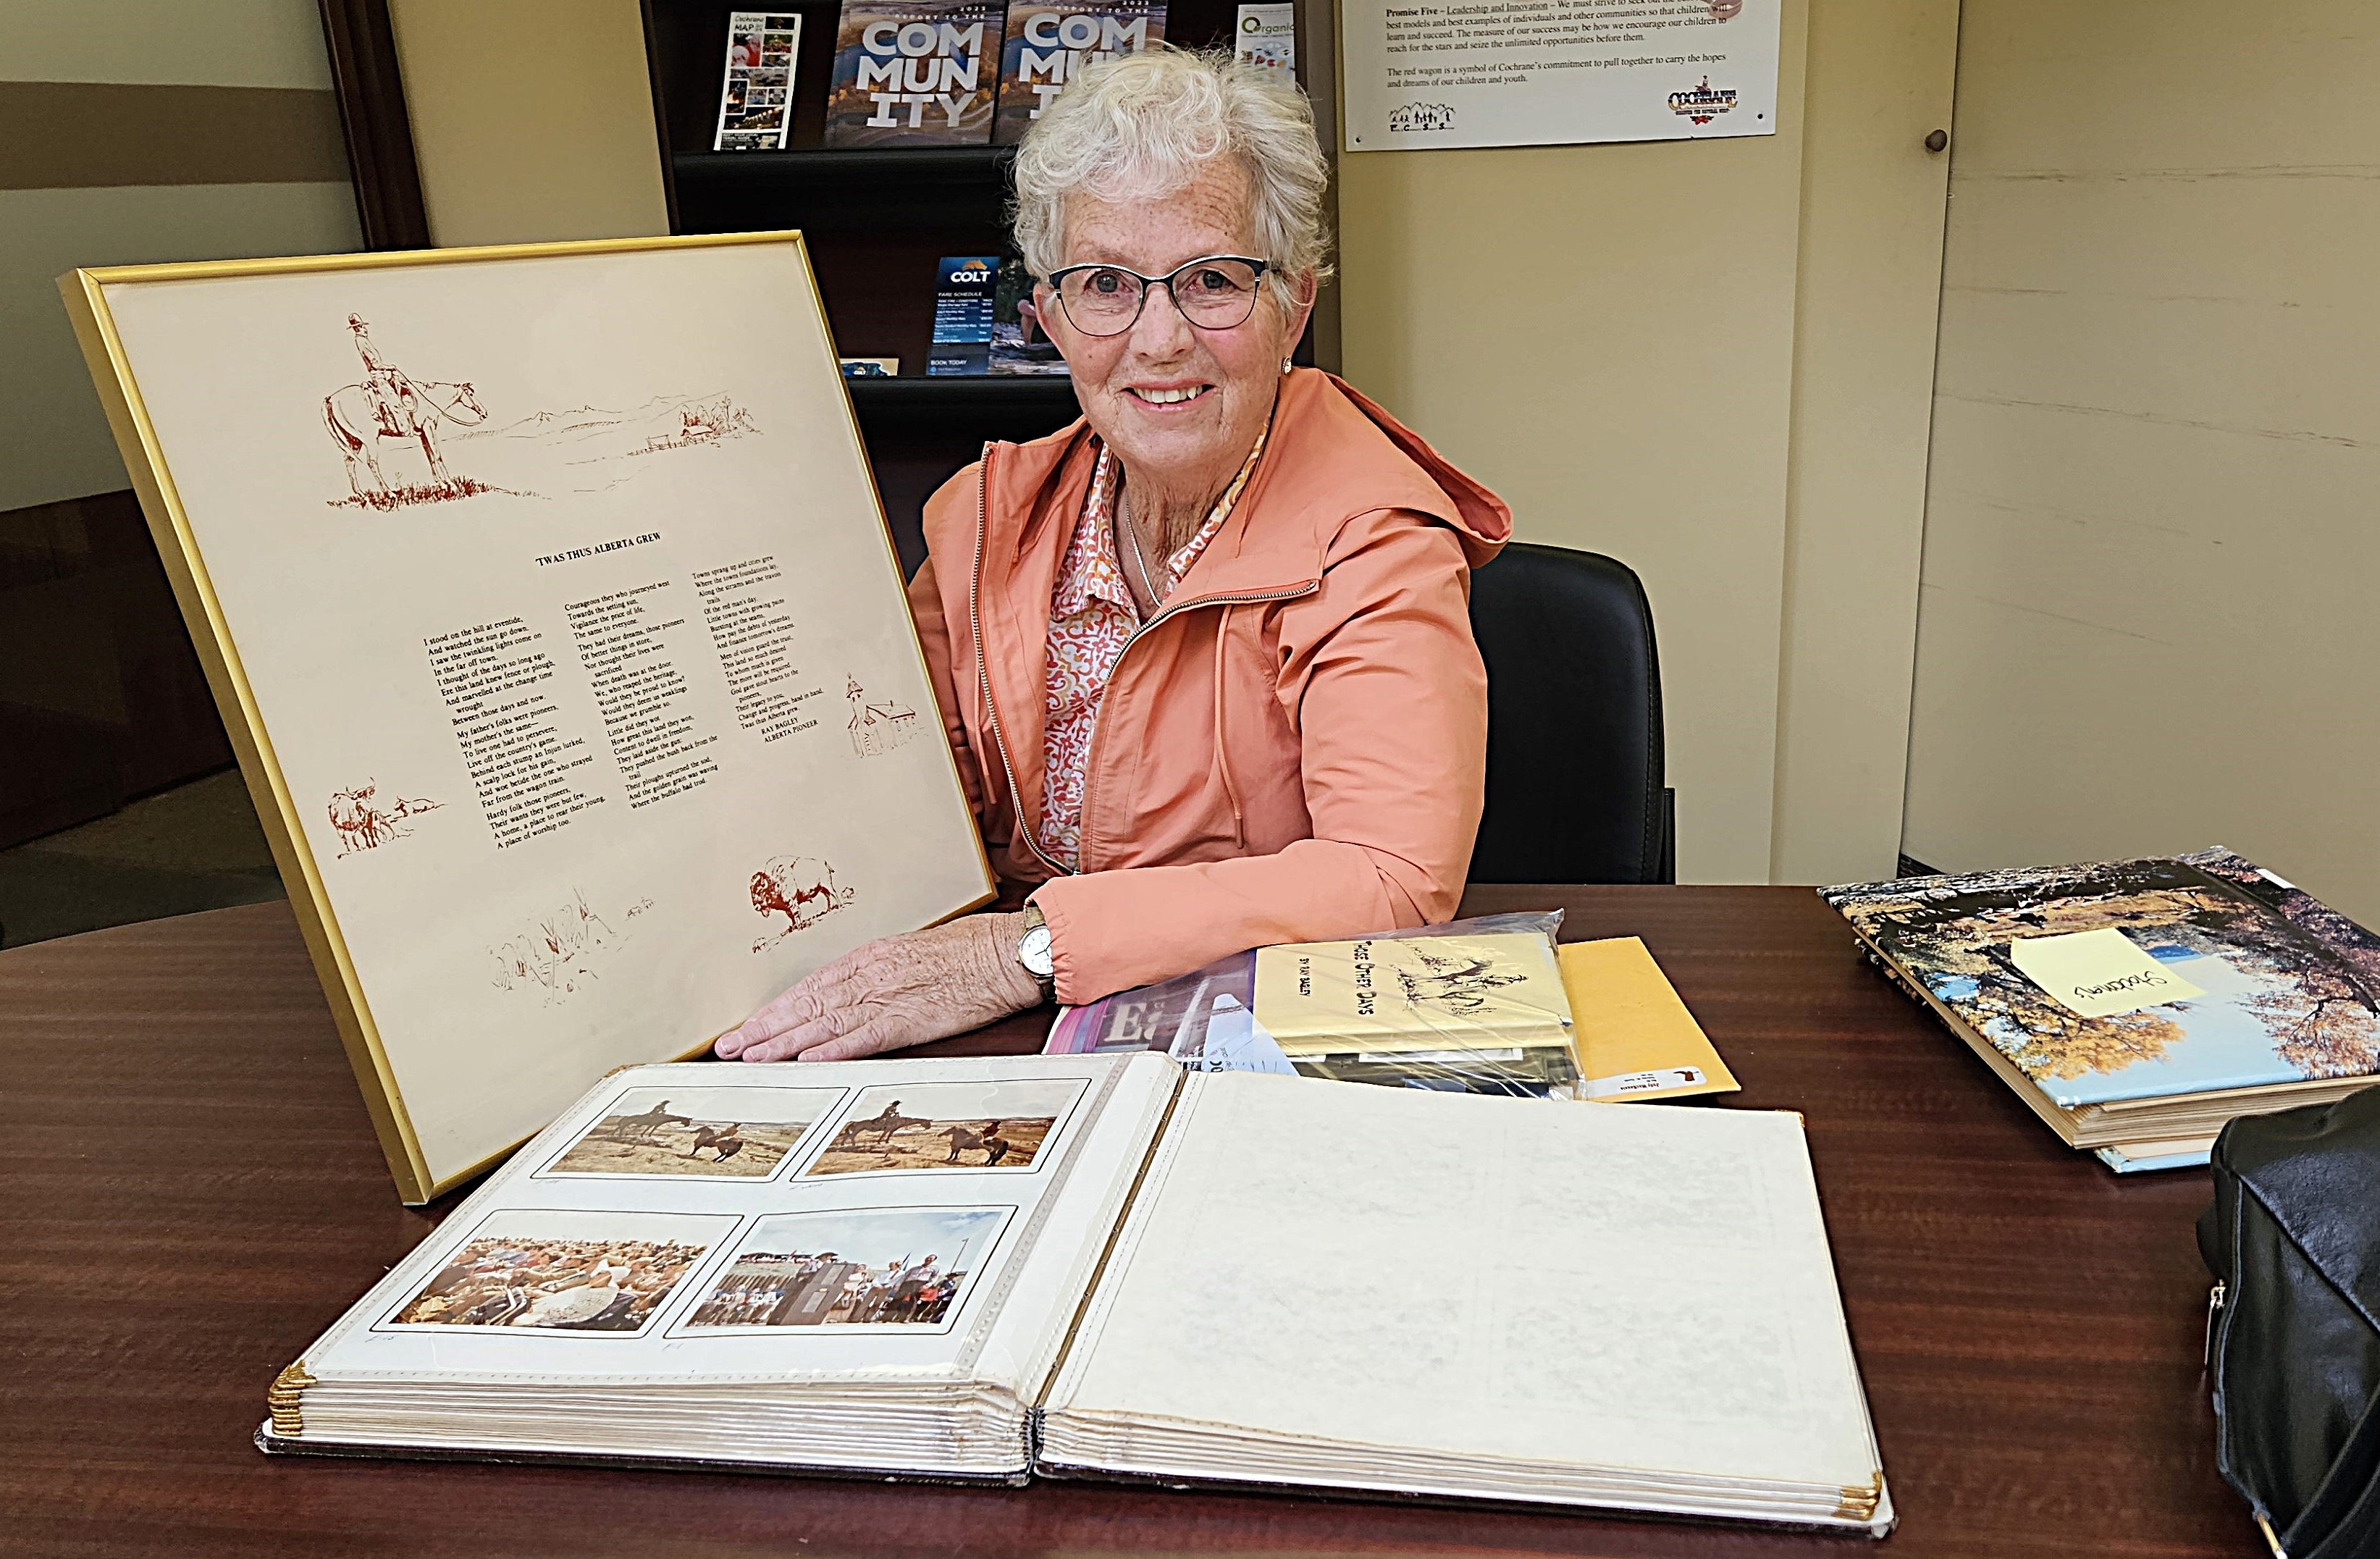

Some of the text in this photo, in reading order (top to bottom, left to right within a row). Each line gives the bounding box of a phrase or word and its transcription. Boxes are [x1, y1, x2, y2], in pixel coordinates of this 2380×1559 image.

[1387, 9, 1419, 17] Promise
[1447, 5, 1489, 15] Leadership
[1490, 4, 1505, 13] and
[1506, 1, 1549, 12] Innovation
[1403, 20, 1430, 28] models
[1432, 18, 1446, 27] and
[1465, 16, 1501, 26] examples
[1513, 13, 1555, 22] individuals
[1597, 8, 1647, 18] communities
[1676, 5, 1710, 14] children
[1712, 4, 1728, 12] will
[862, 21, 984, 56] COM
[1024, 12, 1148, 51] COM
[1458, 64, 1486, 75] symbol
[1488, 63, 1497, 72] of
[1498, 62, 1541, 71] Cochrane's
[1544, 59, 1591, 69] commitment
[1604, 58, 1619, 68] pull
[1621, 56, 1654, 67] together
[1702, 54, 1726, 63] hopes
[857, 56, 980, 93] MUN
[1431, 77, 1439, 86] of
[1504, 74, 1527, 85] youth.
[866, 93, 977, 127] ITY
[950, 271, 991, 282] COLT
[566, 547, 591, 560] THUS
[595, 539, 634, 554] ALBERTA
[636, 532, 660, 544] GREW
[565, 599, 600, 610] Courageous
[629, 583, 656, 597] journeyed
[567, 609, 594, 620] Towards
[571, 619, 598, 629] Vigilance
[611, 612, 624, 621] price
[429, 634, 448, 644] stood
[495, 616, 523, 628] eventide,
[613, 619, 639, 629] everyone.
[429, 646, 442, 655] And
[445, 639, 471, 650] watched
[463, 646, 494, 657] twinkling
[495, 640, 513, 650] lights
[468, 658, 477, 667] off
[442, 673, 469, 684] thought
[611, 673, 626, 683] death
[761, 717, 797, 734] RAY BAGLEY
[765, 720, 817, 743] ALBERTA PIONEER
[487, 789, 571, 820] Hardy folk those pioneers,
[505, 837, 521, 848] place
[532, 824, 556, 836] worship
[1299, 966, 1310, 976] RAY
[1353, 941, 1376, 1014] THOSE OTHER DAYS
[1299, 978, 1311, 996] BAGLEY
